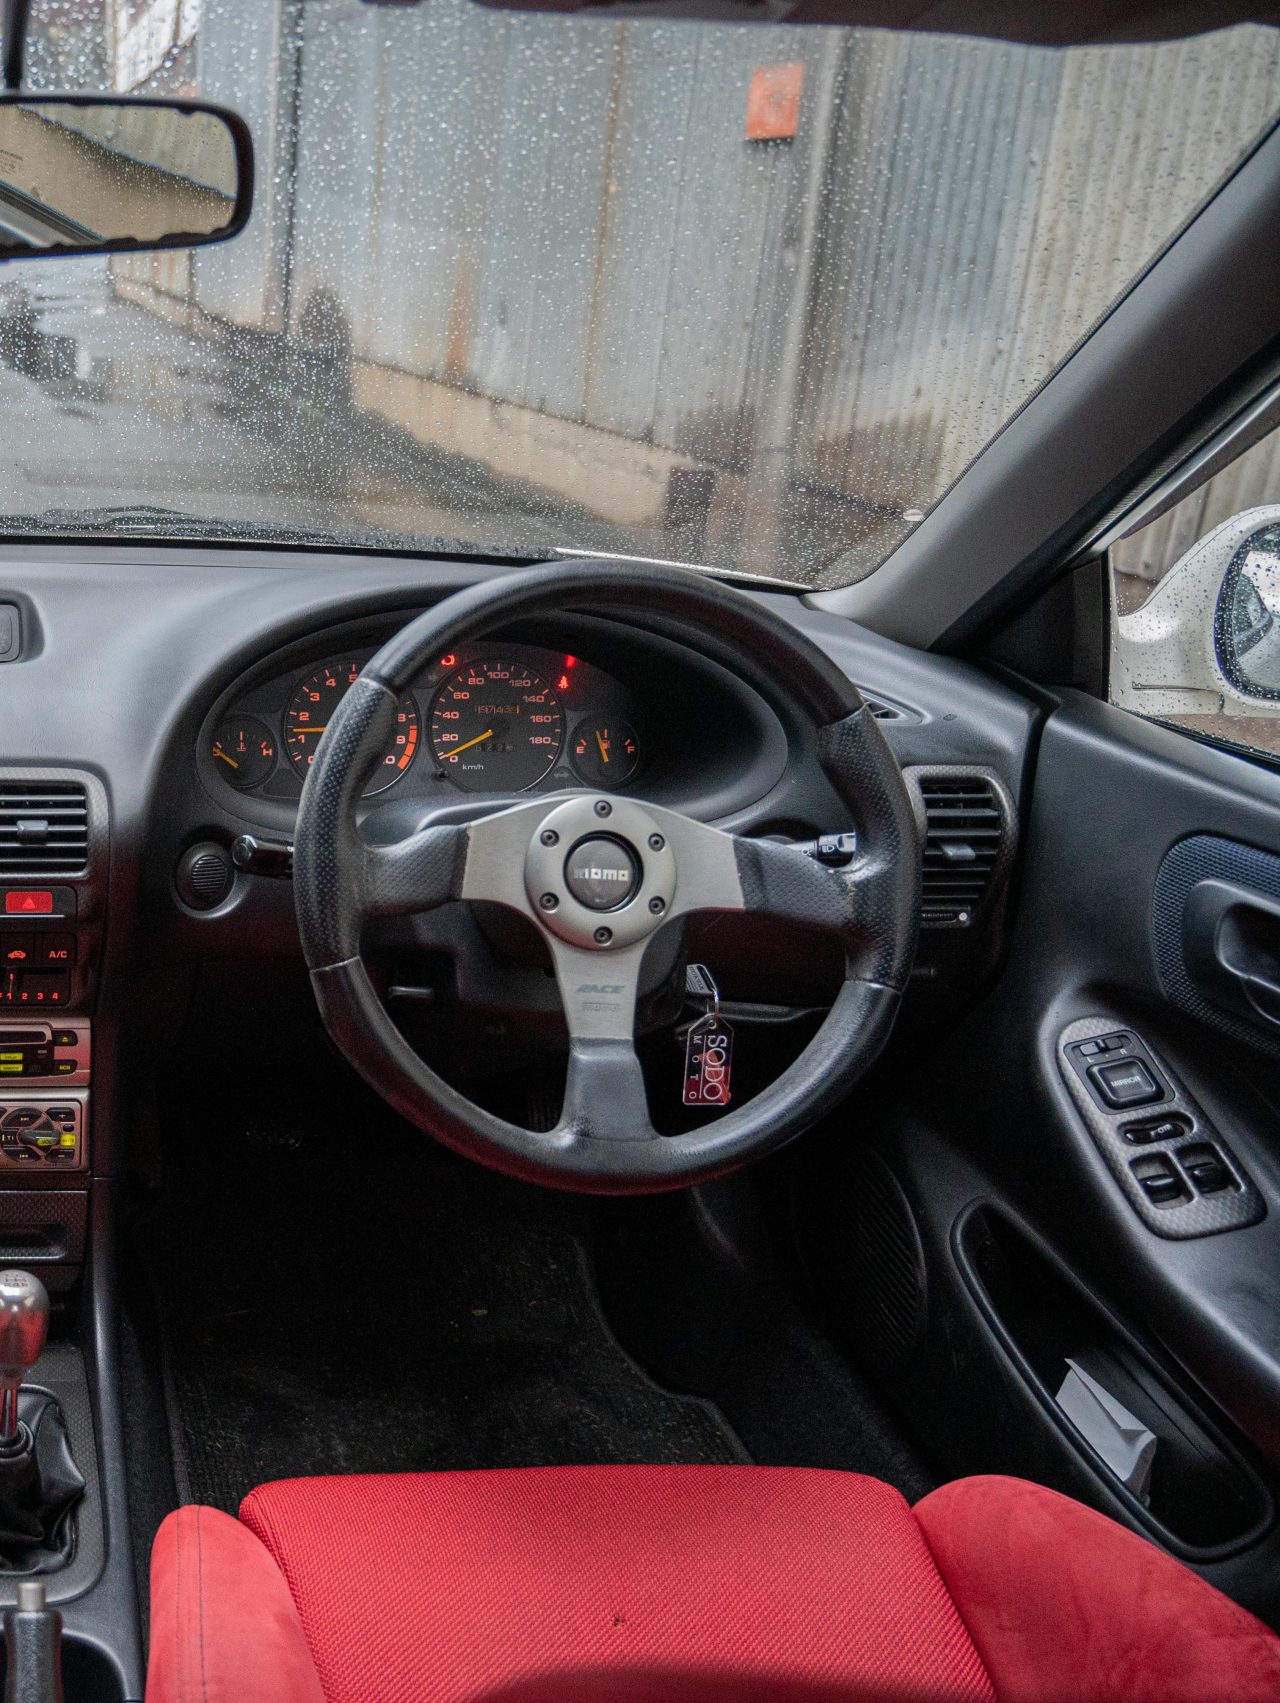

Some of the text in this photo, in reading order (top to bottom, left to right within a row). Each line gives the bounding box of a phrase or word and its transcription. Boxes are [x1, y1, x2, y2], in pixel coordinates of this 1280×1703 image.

[487, 671, 509, 679] 100
[326, 678, 336, 687] 4
[468, 677, 484, 685] 80
[509, 679, 531, 687] 120
[310, 692, 320, 701] 3
[453, 691, 469, 700] 60
[523, 695, 544, 703] 140
[299, 712, 309, 721] 2
[442, 711, 459, 720] 40
[530, 715, 551, 724] 160
[298, 734, 305, 743] 1
[396, 735, 406, 744] 9
[442, 733, 458, 742] 20
[529, 736, 551, 745] 180
[262, 749, 272, 757] H
[576, 746, 584, 754] E
[628, 746, 635, 754] F
[450, 755, 458, 763] 0
[462, 763, 484, 771] km/h
[49, 950, 67, 958] A/C
[7, 992, 12, 1000] 1
[22, 992, 28, 1000] 2
[37, 992, 44, 1000] 3
[52, 992, 59, 1000] 4
[688, 1035, 702, 1099] MOTO
[703, 1035, 728, 1100] SODO
[1110, 1076, 1141, 1087] MIRROR
